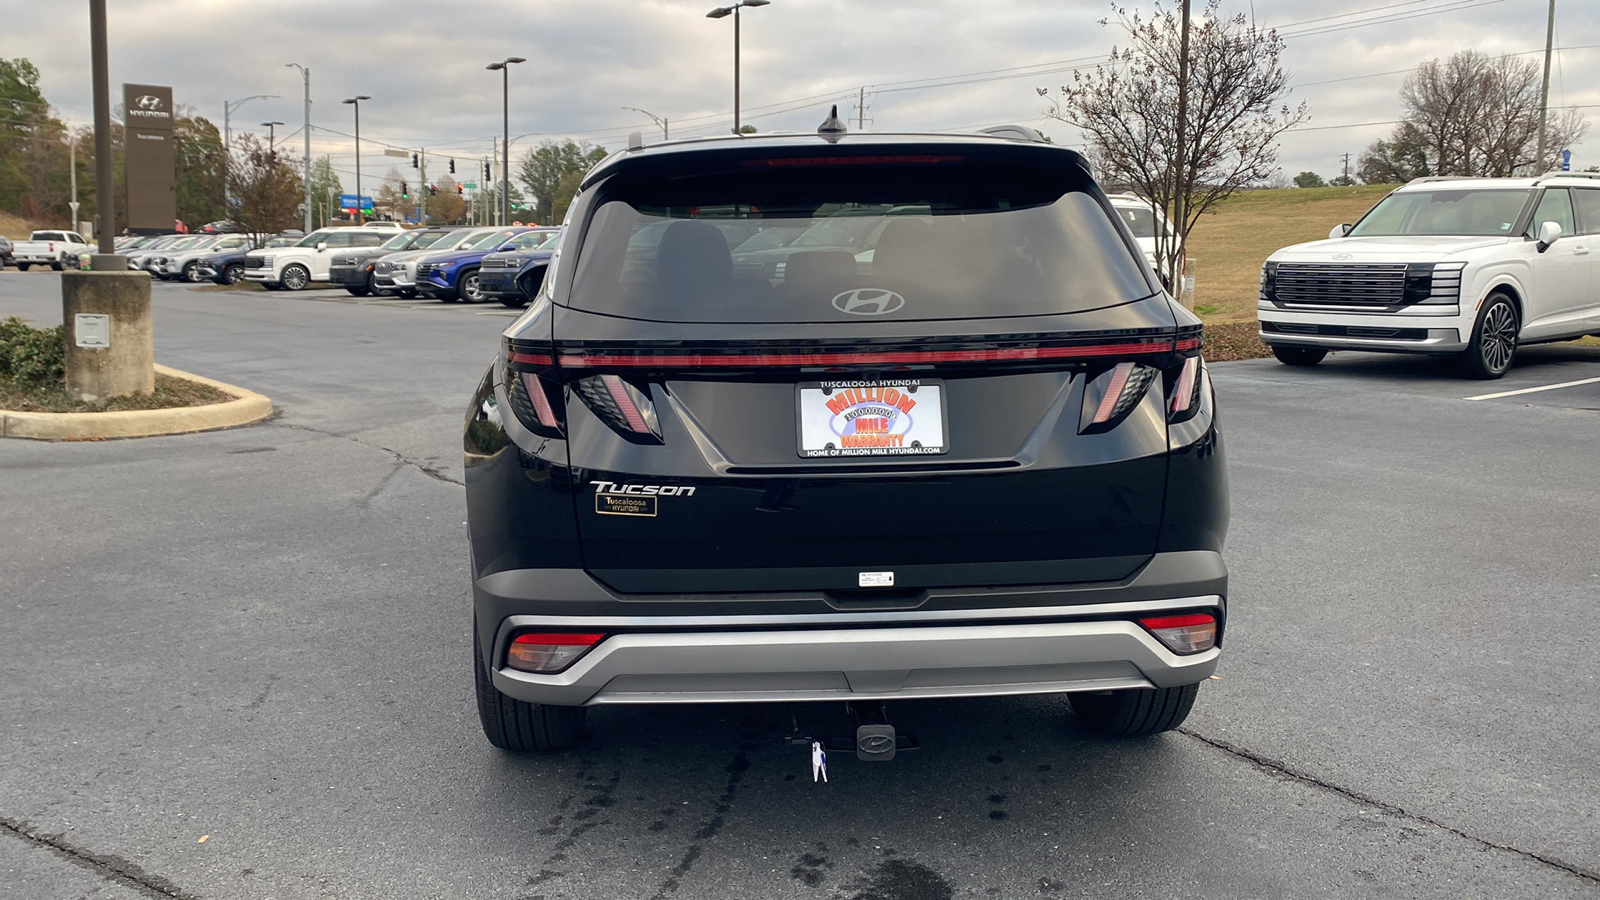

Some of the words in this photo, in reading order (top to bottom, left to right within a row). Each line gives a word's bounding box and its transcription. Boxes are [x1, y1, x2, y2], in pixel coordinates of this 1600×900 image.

[129, 110, 169, 118] HYUNDAI
[820, 380, 877, 388] TUSCALOOSA
[879, 379, 920, 387] HYUNDAI
[825, 387, 917, 416] MILLION
[855, 418, 888, 434] MILE
[840, 434, 905, 448] WARRANTY
[606, 496, 647, 506] Tuscaloosa
